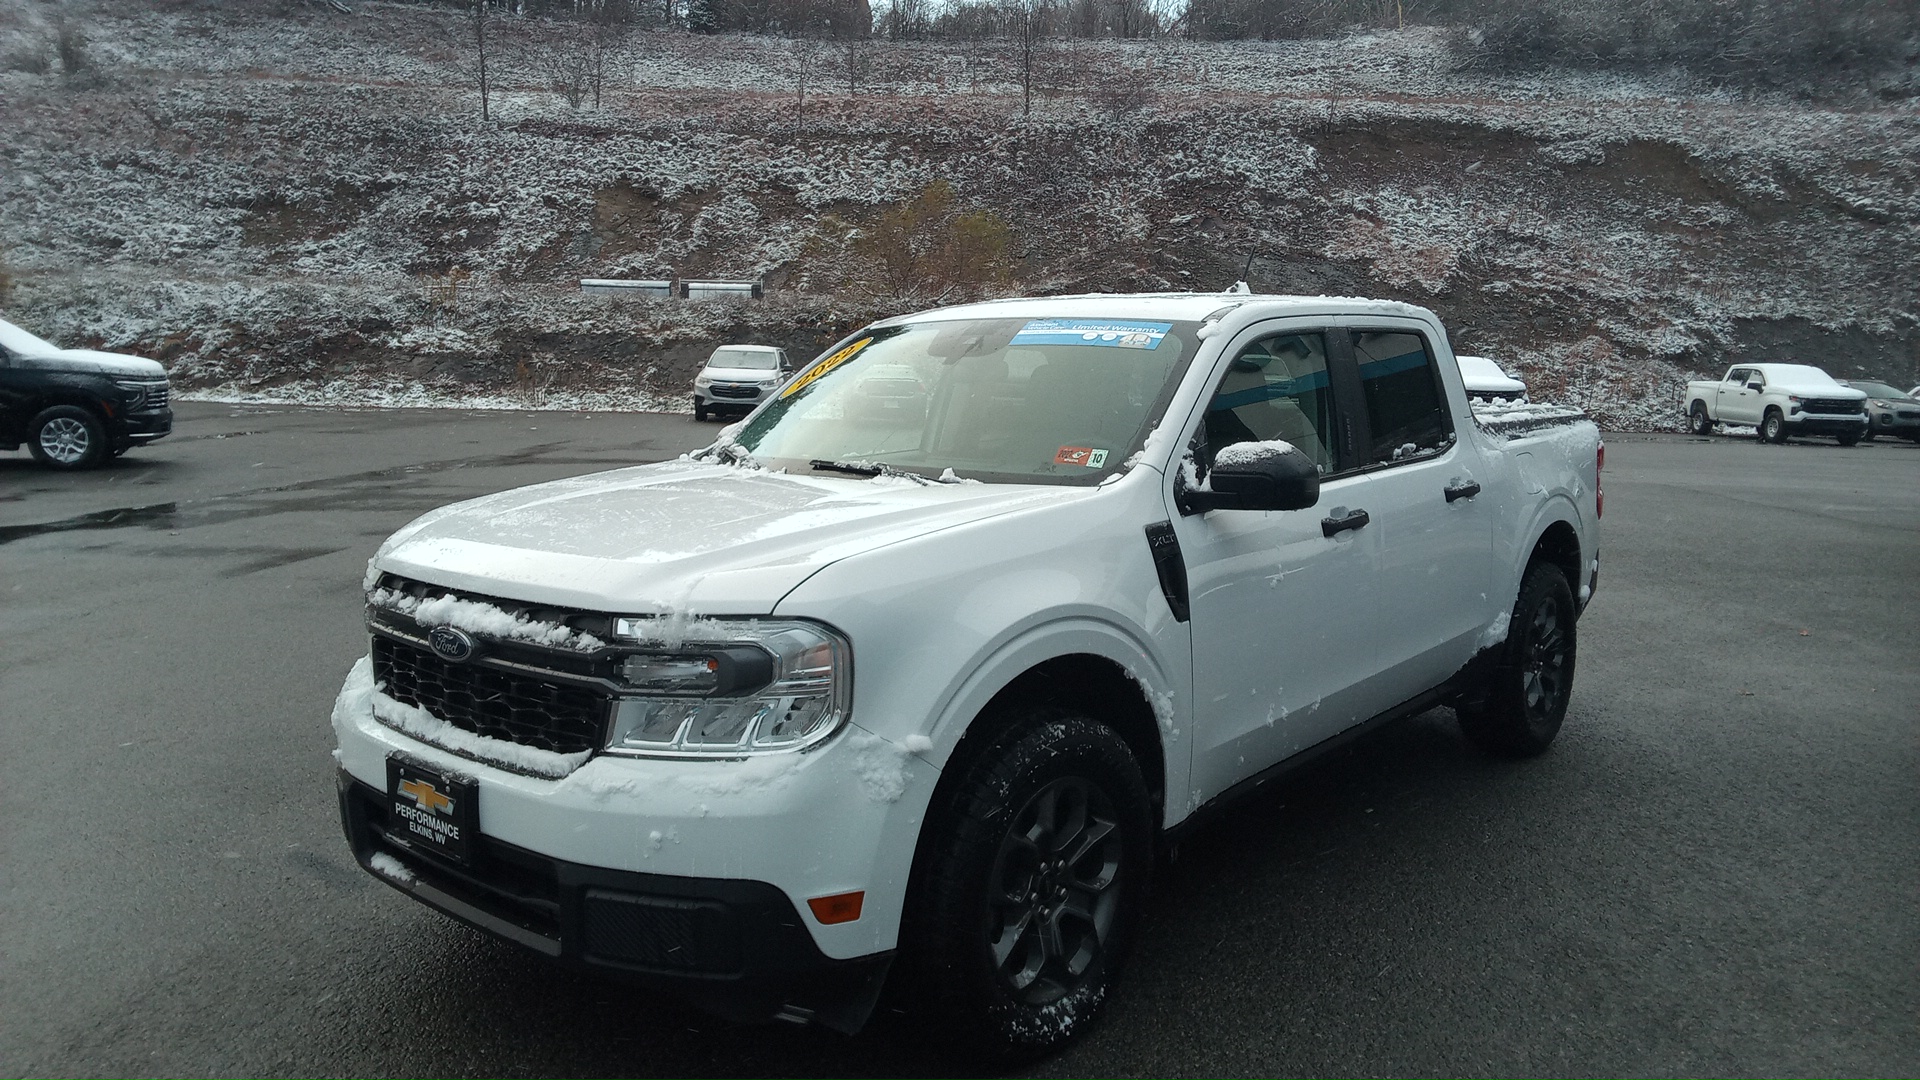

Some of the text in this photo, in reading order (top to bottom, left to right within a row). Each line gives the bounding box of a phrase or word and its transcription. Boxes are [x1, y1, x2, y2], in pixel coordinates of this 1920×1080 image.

[1112, 325, 1160, 334] Warranty
[796, 345, 856, 390] 2022
[1092, 453, 1103, 464] 10
[1151, 533, 1175, 547] XLT
[435, 633, 459, 655] Ford
[394, 802, 460, 841] PERFORMANCE
[409, 821, 446, 846] ELKINS, WV
